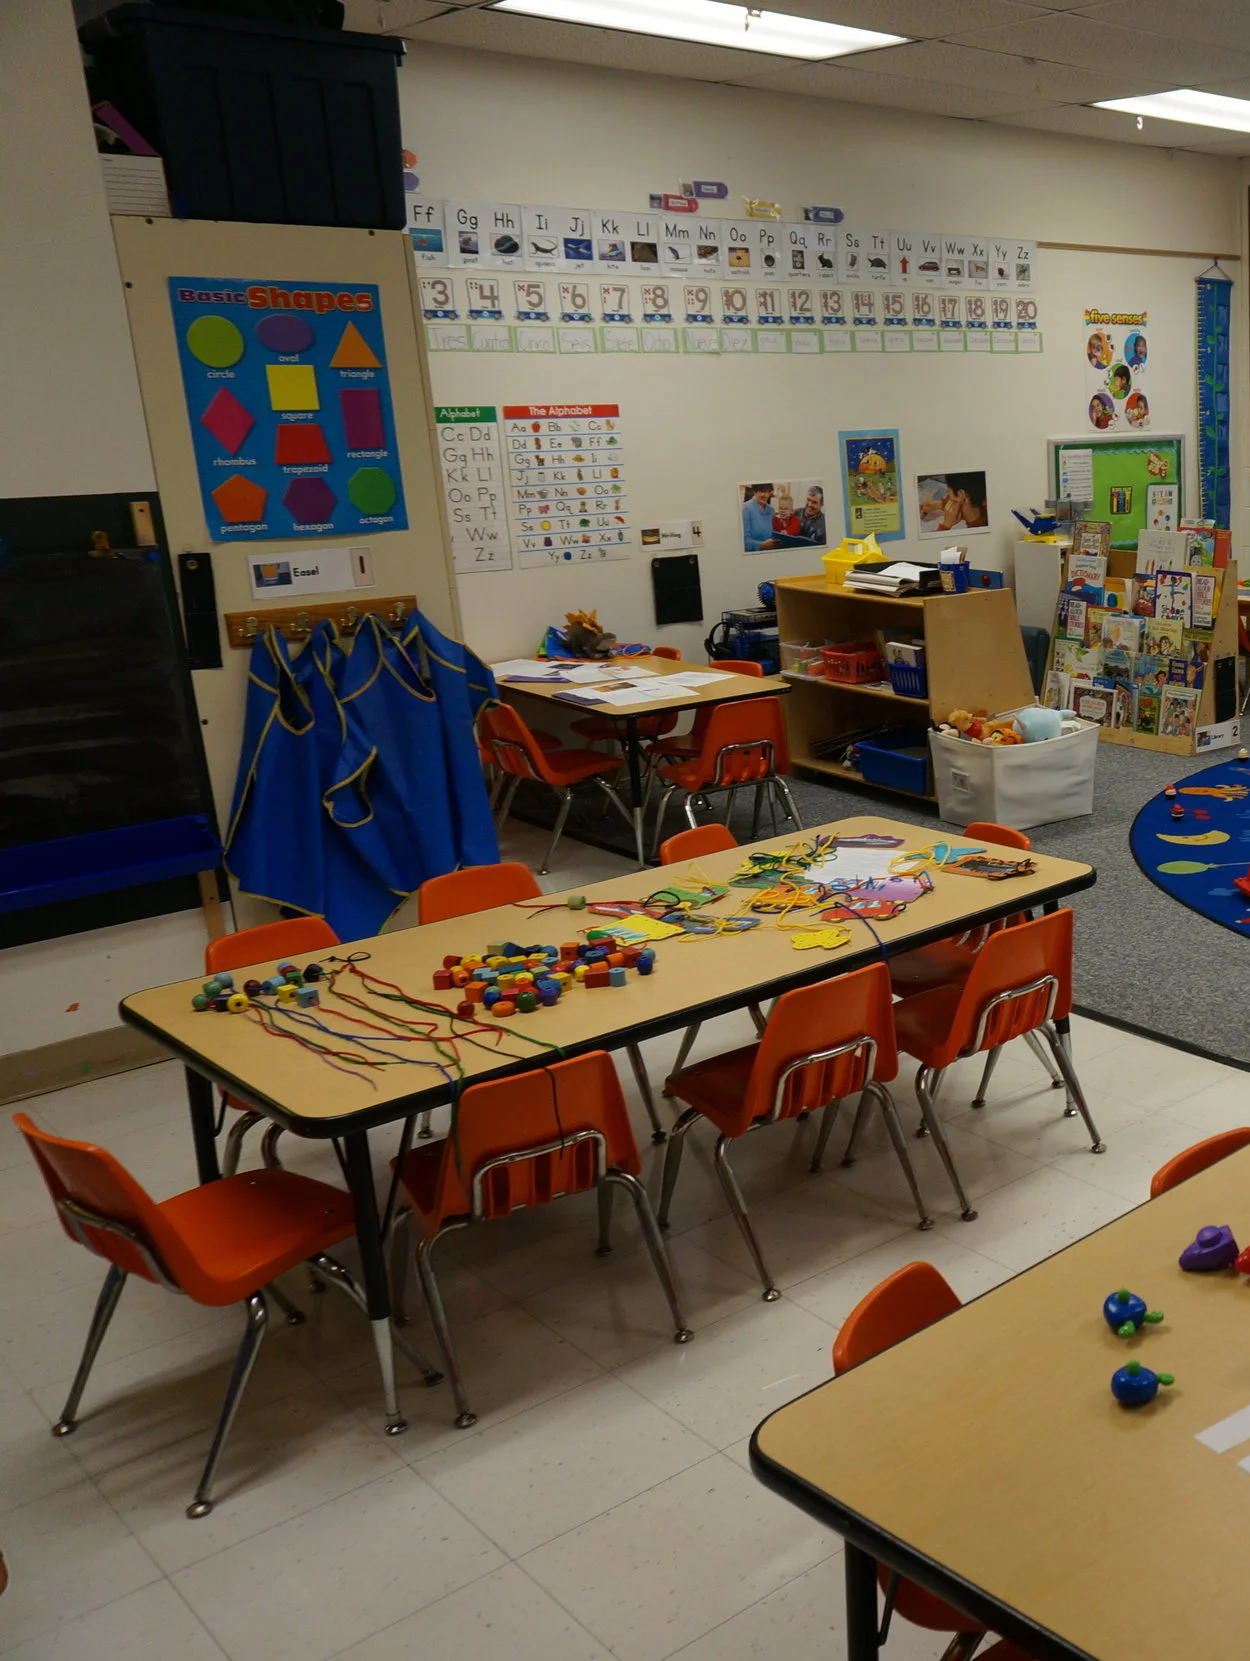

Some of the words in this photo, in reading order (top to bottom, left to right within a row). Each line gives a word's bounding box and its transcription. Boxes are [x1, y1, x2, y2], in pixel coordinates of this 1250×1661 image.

[413, 205, 434, 223] Ff
[457, 209, 478, 230] Gg
[494, 212, 515, 229] Hh
[535, 214, 549, 230] Ii
[569, 217, 585, 237] Jj
[601, 219, 620, 235] Kk
[637, 221, 649, 237] Ll
[665, 223, 689, 238] Mm
[699, 225, 716, 240] Nn
[730, 228, 747, 242] Oo
[759, 229, 774, 247] Pp
[790, 231, 807, 249] Qq
[818, 232, 832, 247] Rr
[846, 233, 860, 248] Ss
[872, 236, 885, 249] Tt
[897, 238, 912, 252] Uu
[923, 240, 936, 253] Vv
[945, 242, 965, 255] Ww
[972, 243, 984, 257] Xx
[995, 245, 1007, 261] Yy
[1017, 246, 1029, 260] Zz
[177, 288, 246, 304] Basic
[245, 285, 374, 314] Shapes
[431, 280, 449, 306] 3
[478, 284, 498, 308] 4
[526, 284, 543, 308] 5
[571, 285, 586, 310] 6
[612, 287, 626, 310] 7
[652, 286, 668, 309] 8
[695, 287, 708, 311] 9
[723, 289, 746, 312] 10
[759, 291, 775, 312] 11
[790, 291, 811, 312] 12
[822, 291, 841, 312] 13
[854, 293, 874, 314] 14
[883, 295, 903, 315] 15
[914, 295, 931, 315] 16
[941, 298, 958, 317] 17
[967, 298, 985, 317] 18
[993, 298, 1008, 319] 19
[1016, 300, 1037, 320] 20
[1089, 309, 1110, 324] five
[1111, 312, 1145, 325] senses
[431, 327, 465, 349] Tres
[278, 353, 300, 363] oval
[206, 370, 236, 379] circle
[340, 369, 376, 380] triangle
[281, 412, 314, 421] square
[440, 408, 481, 422] Alphabet
[528, 406, 546, 416] The
[548, 406, 592, 418] Alphabet
[440, 426, 464, 442] Cc
[469, 426, 491, 441] Dd
[511, 423, 527, 433] Aa
[548, 421, 562, 432] Bb
[588, 421, 601, 431] Cc
[512, 440, 527, 450] Dd
[550, 439, 563, 449] Ee
[589, 437, 603, 447] Ff
[347, 449, 389, 460] rectangle
[442, 447, 467, 469] Gg
[471, 447, 494, 461] Hh
[514, 454, 530, 468] Gg
[551, 455, 565, 464] Hh
[591, 453, 597, 463] Ii
[213, 458, 257, 467] rhombus
[282, 464, 329, 475] trapezoid
[446, 468, 468, 483] Kk
[477, 467, 492, 482] Ll
[518, 470, 529, 485] Jj
[553, 471, 567, 481] Kk
[593, 470, 602, 479] Ll
[448, 488, 471, 503] Oo
[478, 487, 496, 508] Pp
[517, 490, 536, 499] Mm
[555, 488, 568, 497] Nn
[594, 485, 609, 495] Oo
[453, 507, 471, 522] Ss
[480, 506, 497, 520] Tt
[519, 504, 532, 516] Pp
[556, 501, 573, 515] Qq
[596, 501, 608, 510] Rr
[292, 522, 335, 533] hexagon
[359, 516, 394, 525] octagon
[521, 522, 534, 532] Ss
[559, 520, 570, 529] Tt
[597, 517, 610, 527] Uu
[220, 523, 268, 534] pentagon
[466, 527, 498, 541] Ww
[692, 526, 702, 537] 4
[523, 538, 536, 548] Vv
[560, 535, 579, 545] Ww
[599, 533, 612, 543] Xx
[474, 547, 495, 562] Zz
[548, 551, 560, 563] Yy
[580, 550, 592, 560] Zz
[293, 566, 320, 577] Easel
[1071, 570, 1100, 580] DICTIONARY
[1232, 725, 1238, 737] 2
